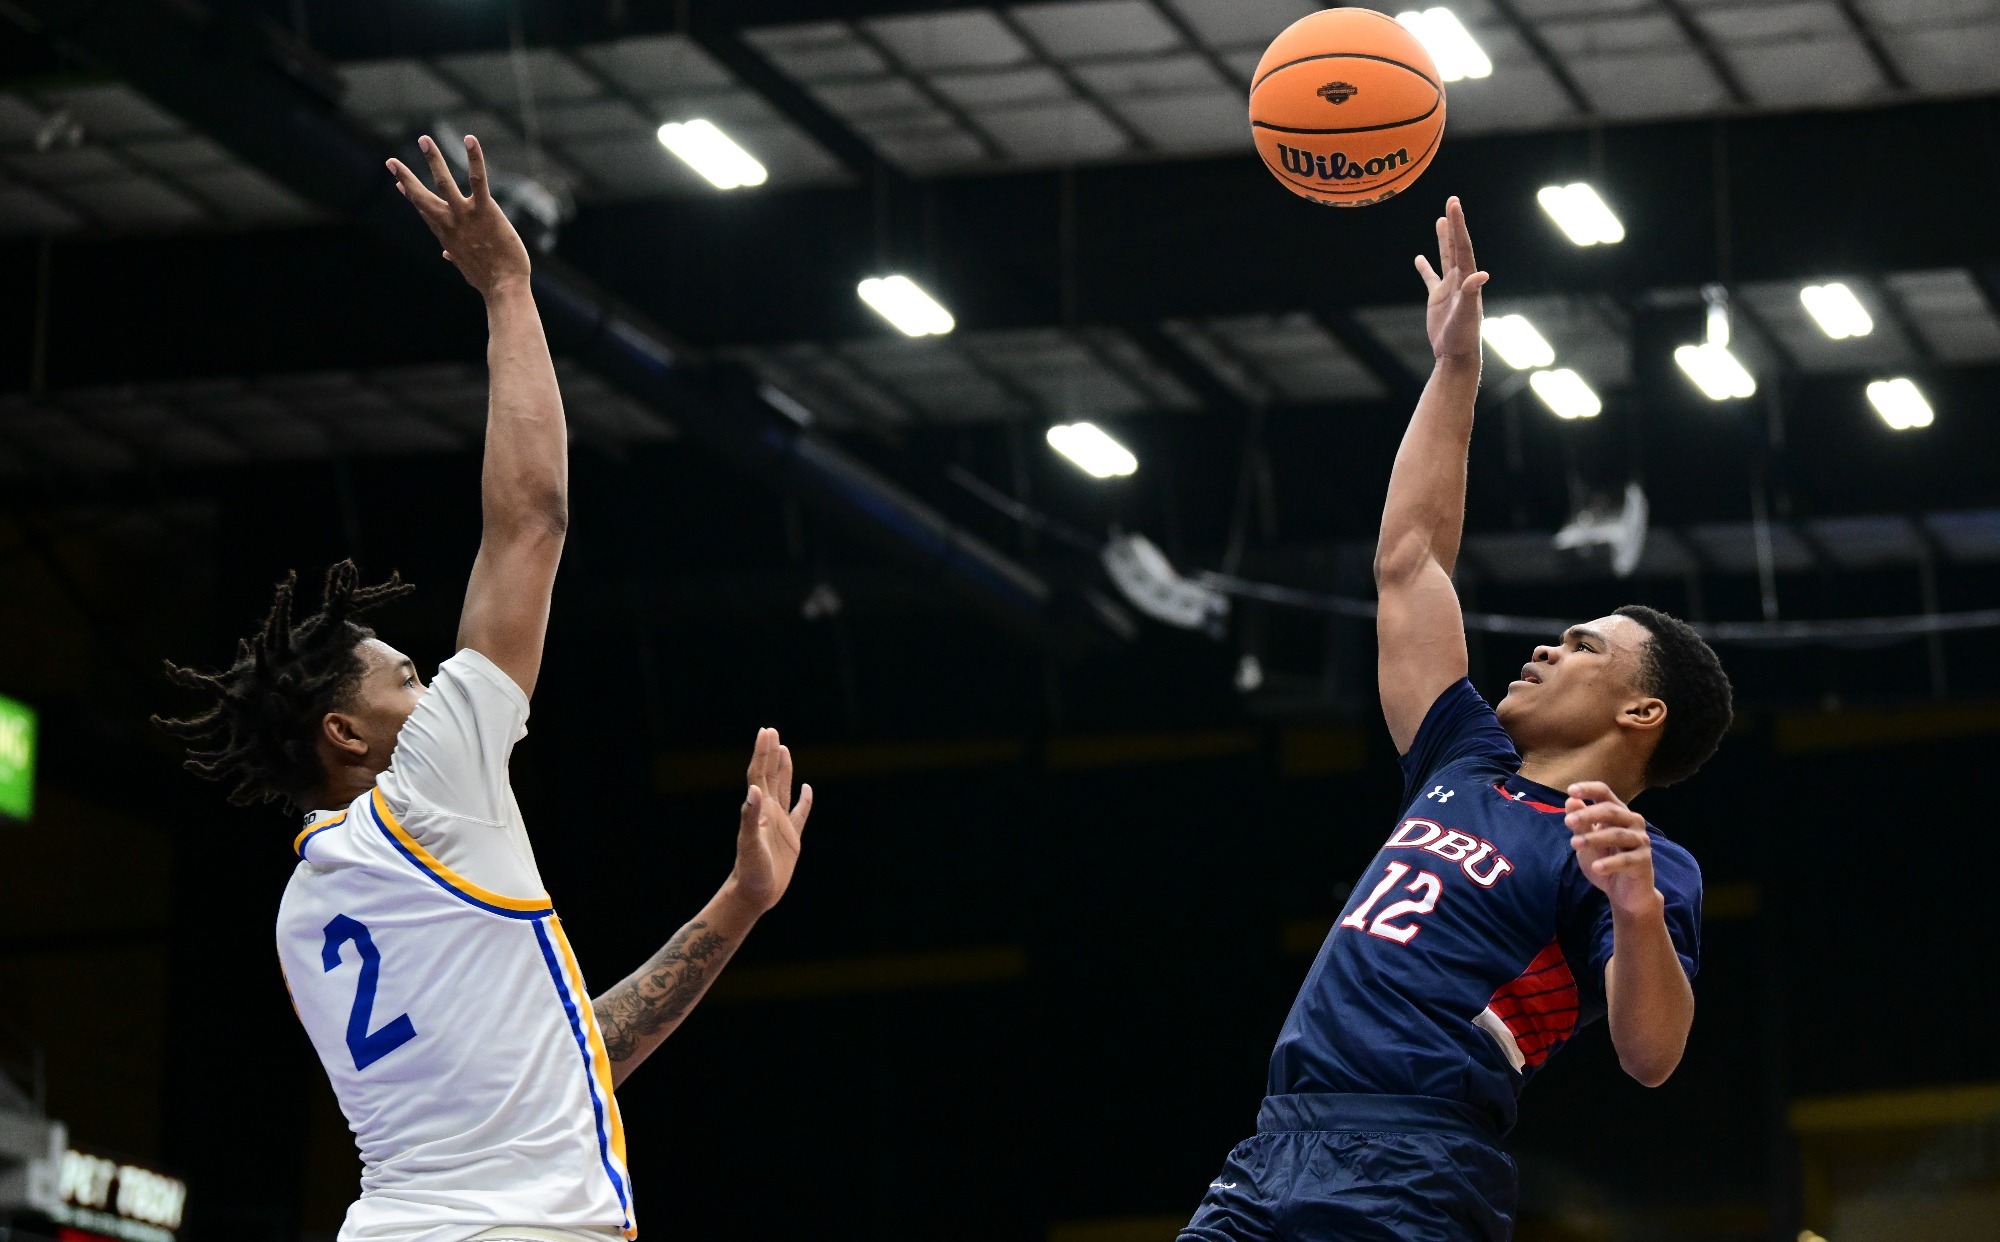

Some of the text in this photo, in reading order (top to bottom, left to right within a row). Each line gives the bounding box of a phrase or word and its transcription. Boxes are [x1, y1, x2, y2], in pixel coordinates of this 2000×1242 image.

[1277, 143, 1409, 180] Wilson
[1382, 817, 1515, 889] DBU
[1340, 860, 1443, 946] 12
[321, 914, 417, 1071] 2
